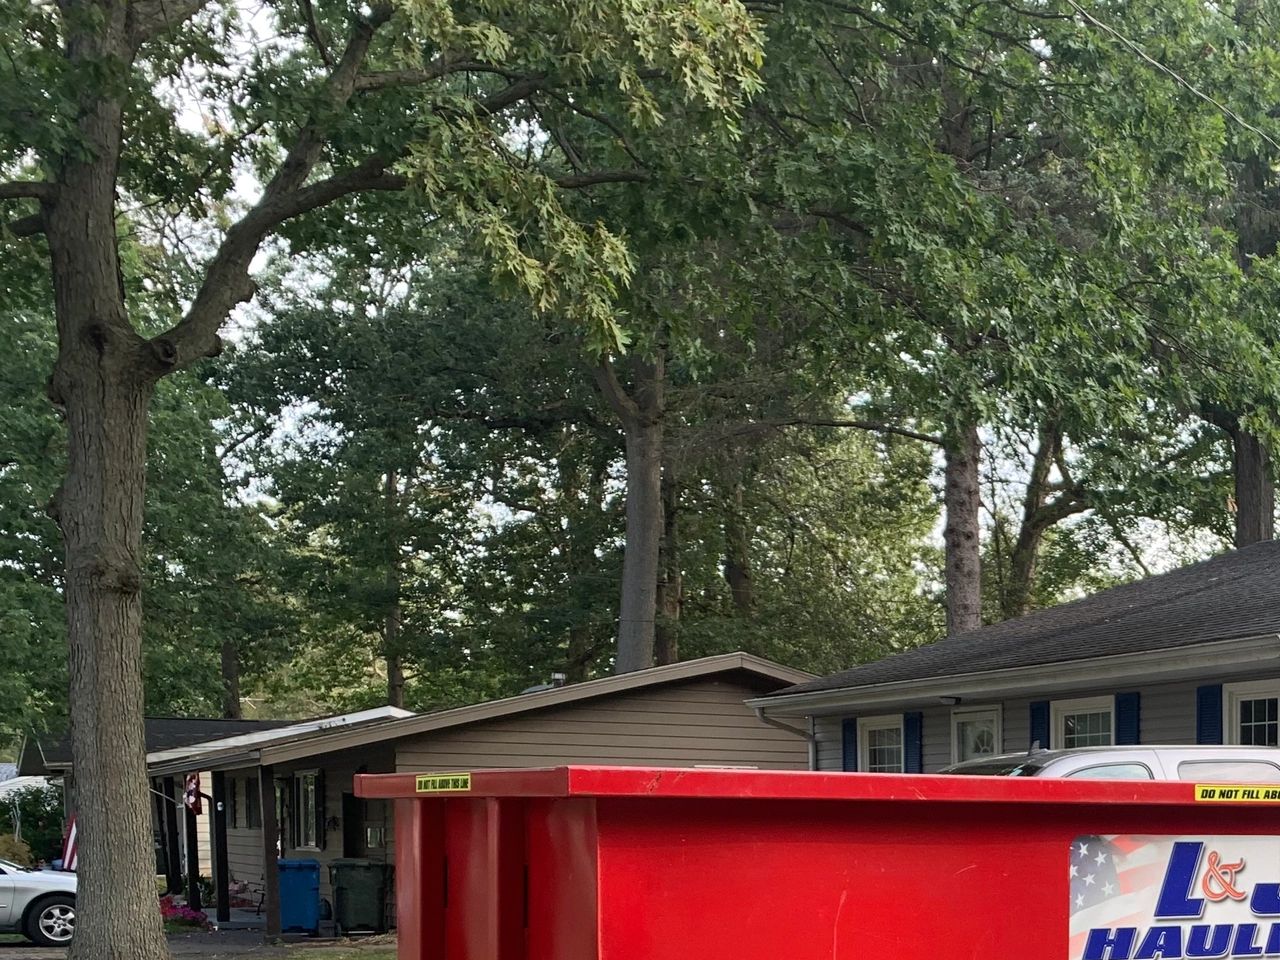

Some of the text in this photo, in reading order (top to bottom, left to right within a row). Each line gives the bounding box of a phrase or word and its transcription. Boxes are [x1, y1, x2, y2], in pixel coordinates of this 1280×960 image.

[1200, 789, 1216, 799] DO
[1218, 789, 1240, 799] NOT
[1241, 789, 1260, 799] FILL
